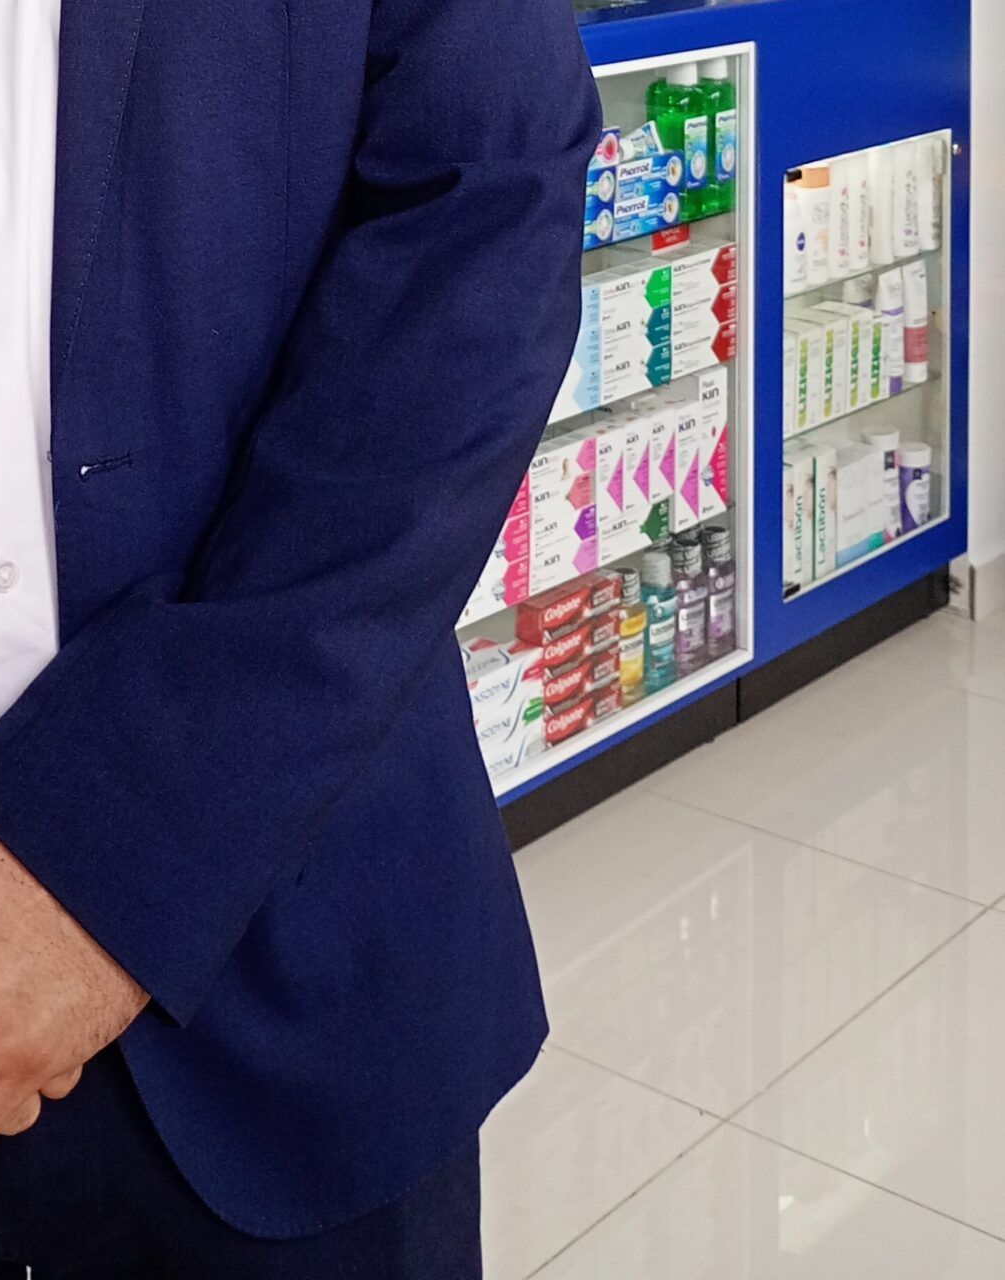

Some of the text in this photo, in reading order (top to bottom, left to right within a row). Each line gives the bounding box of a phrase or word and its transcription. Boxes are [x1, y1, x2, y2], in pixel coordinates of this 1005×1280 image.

[546, 596, 582, 621] Colgate
[546, 633, 582, 659] Colgate
[546, 671, 582, 696] Colgate
[547, 707, 585, 733] Colgate
